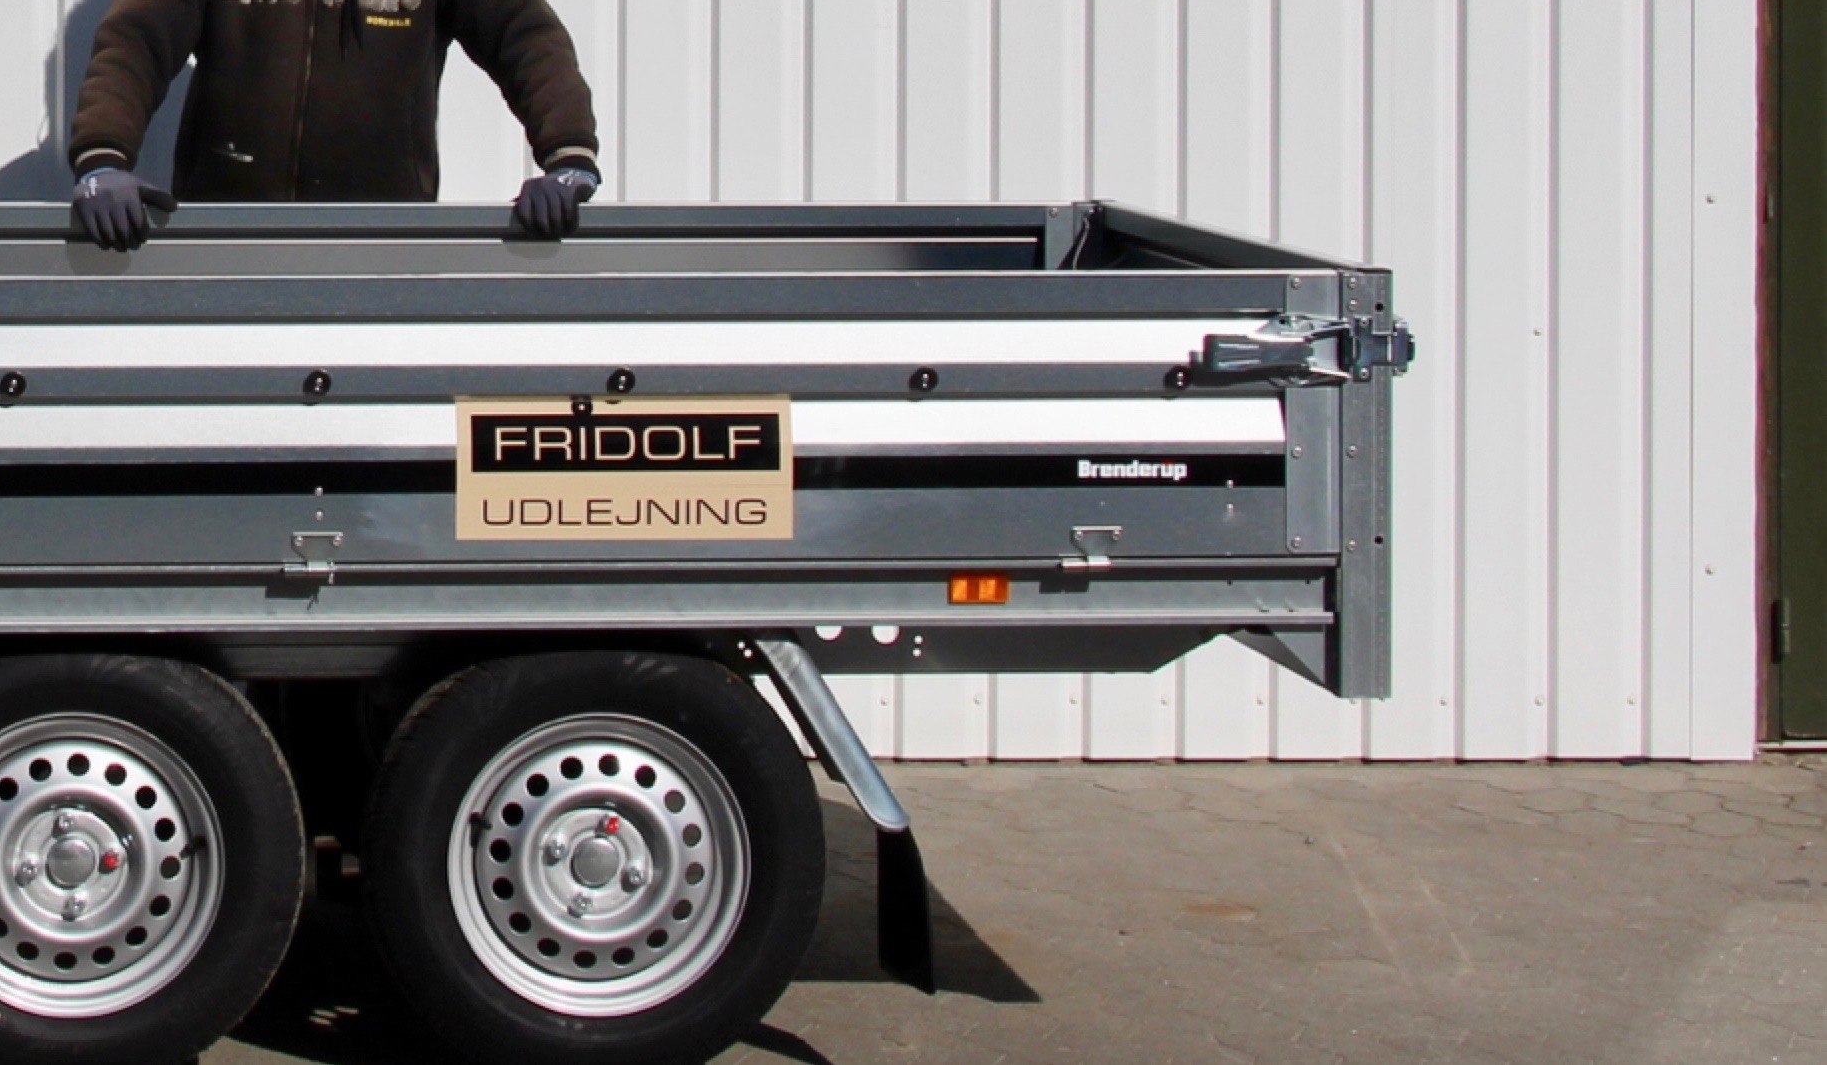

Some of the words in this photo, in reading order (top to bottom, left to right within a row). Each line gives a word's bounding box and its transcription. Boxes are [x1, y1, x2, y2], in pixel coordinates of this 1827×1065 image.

[494, 425, 762, 461] FRIDOLF
[1077, 460, 1188, 481] Brenderup
[482, 499, 768, 526] UDLEJNING
